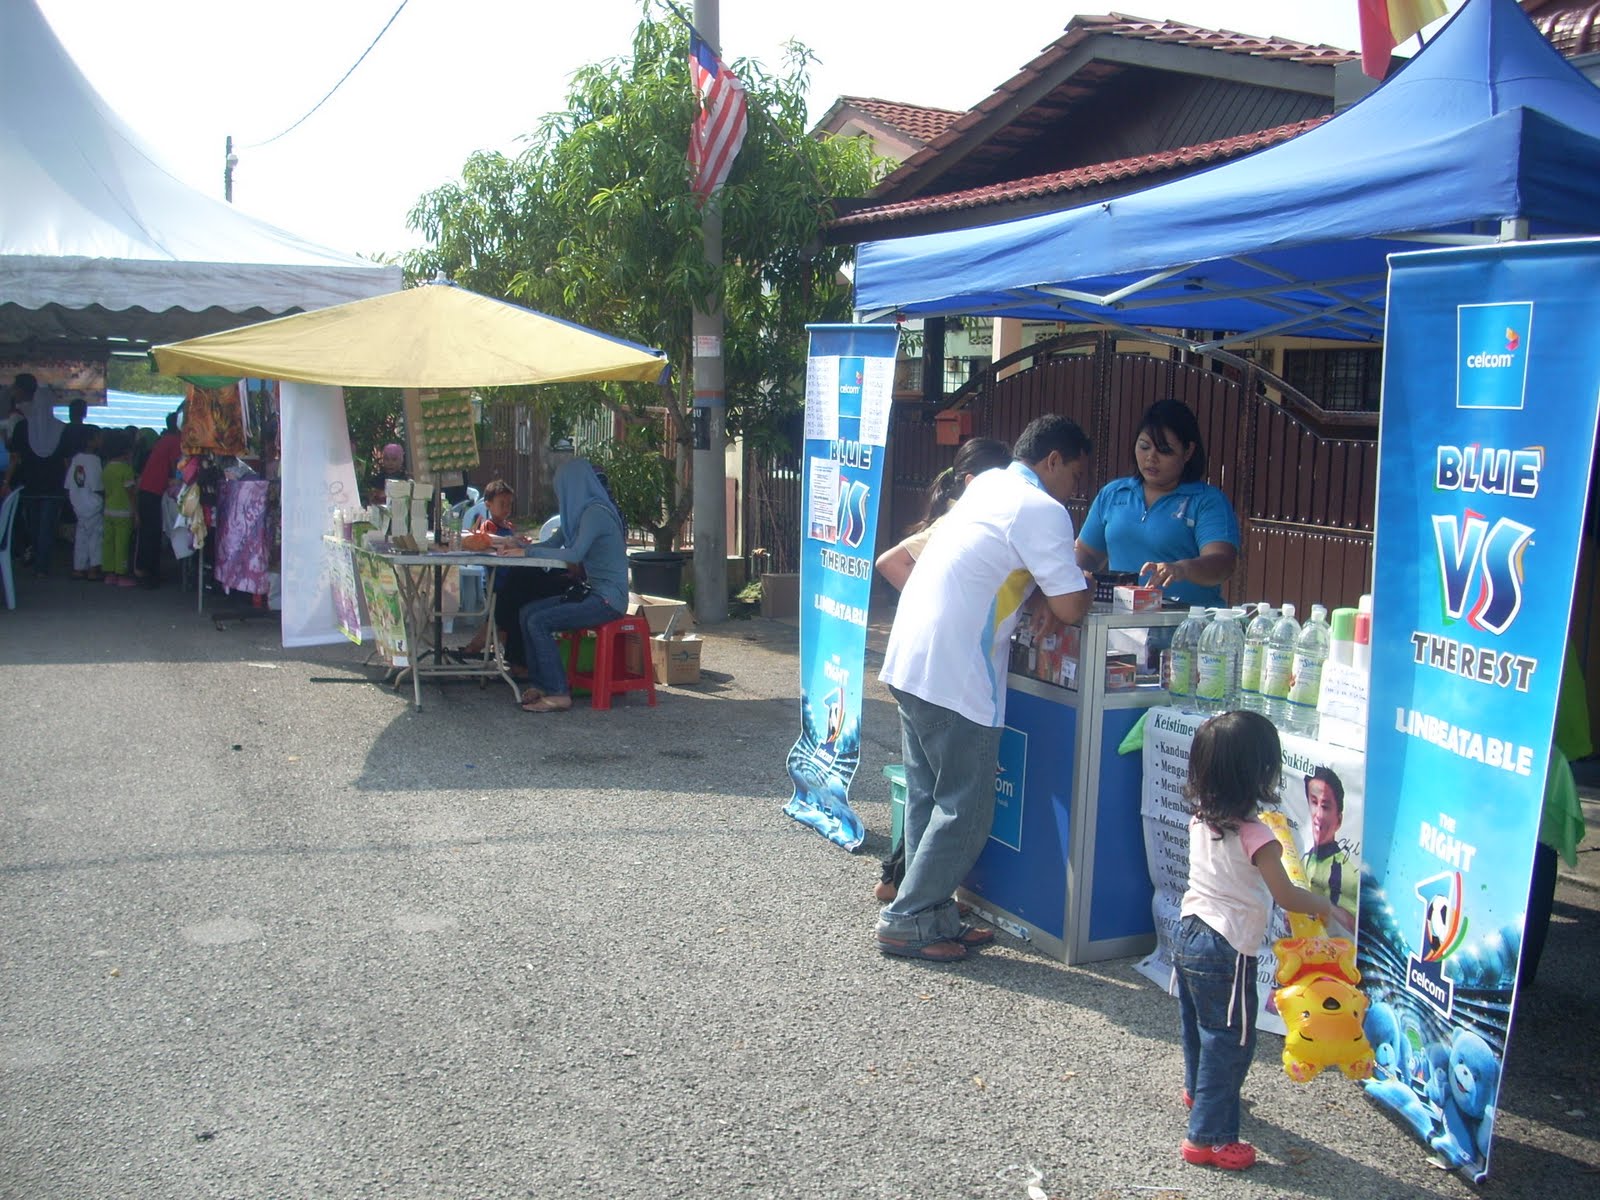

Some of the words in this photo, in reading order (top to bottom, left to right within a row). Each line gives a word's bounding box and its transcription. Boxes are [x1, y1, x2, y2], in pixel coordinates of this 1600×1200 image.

[1467, 351, 1514, 368] celcom
[1436, 445, 1541, 498] BLUE
[1431, 514, 1536, 636] VS
[1282, 749, 1315, 776] Sukida
[1419, 821, 1477, 873] RIGHT
[1411, 969, 1446, 1003] celcom
